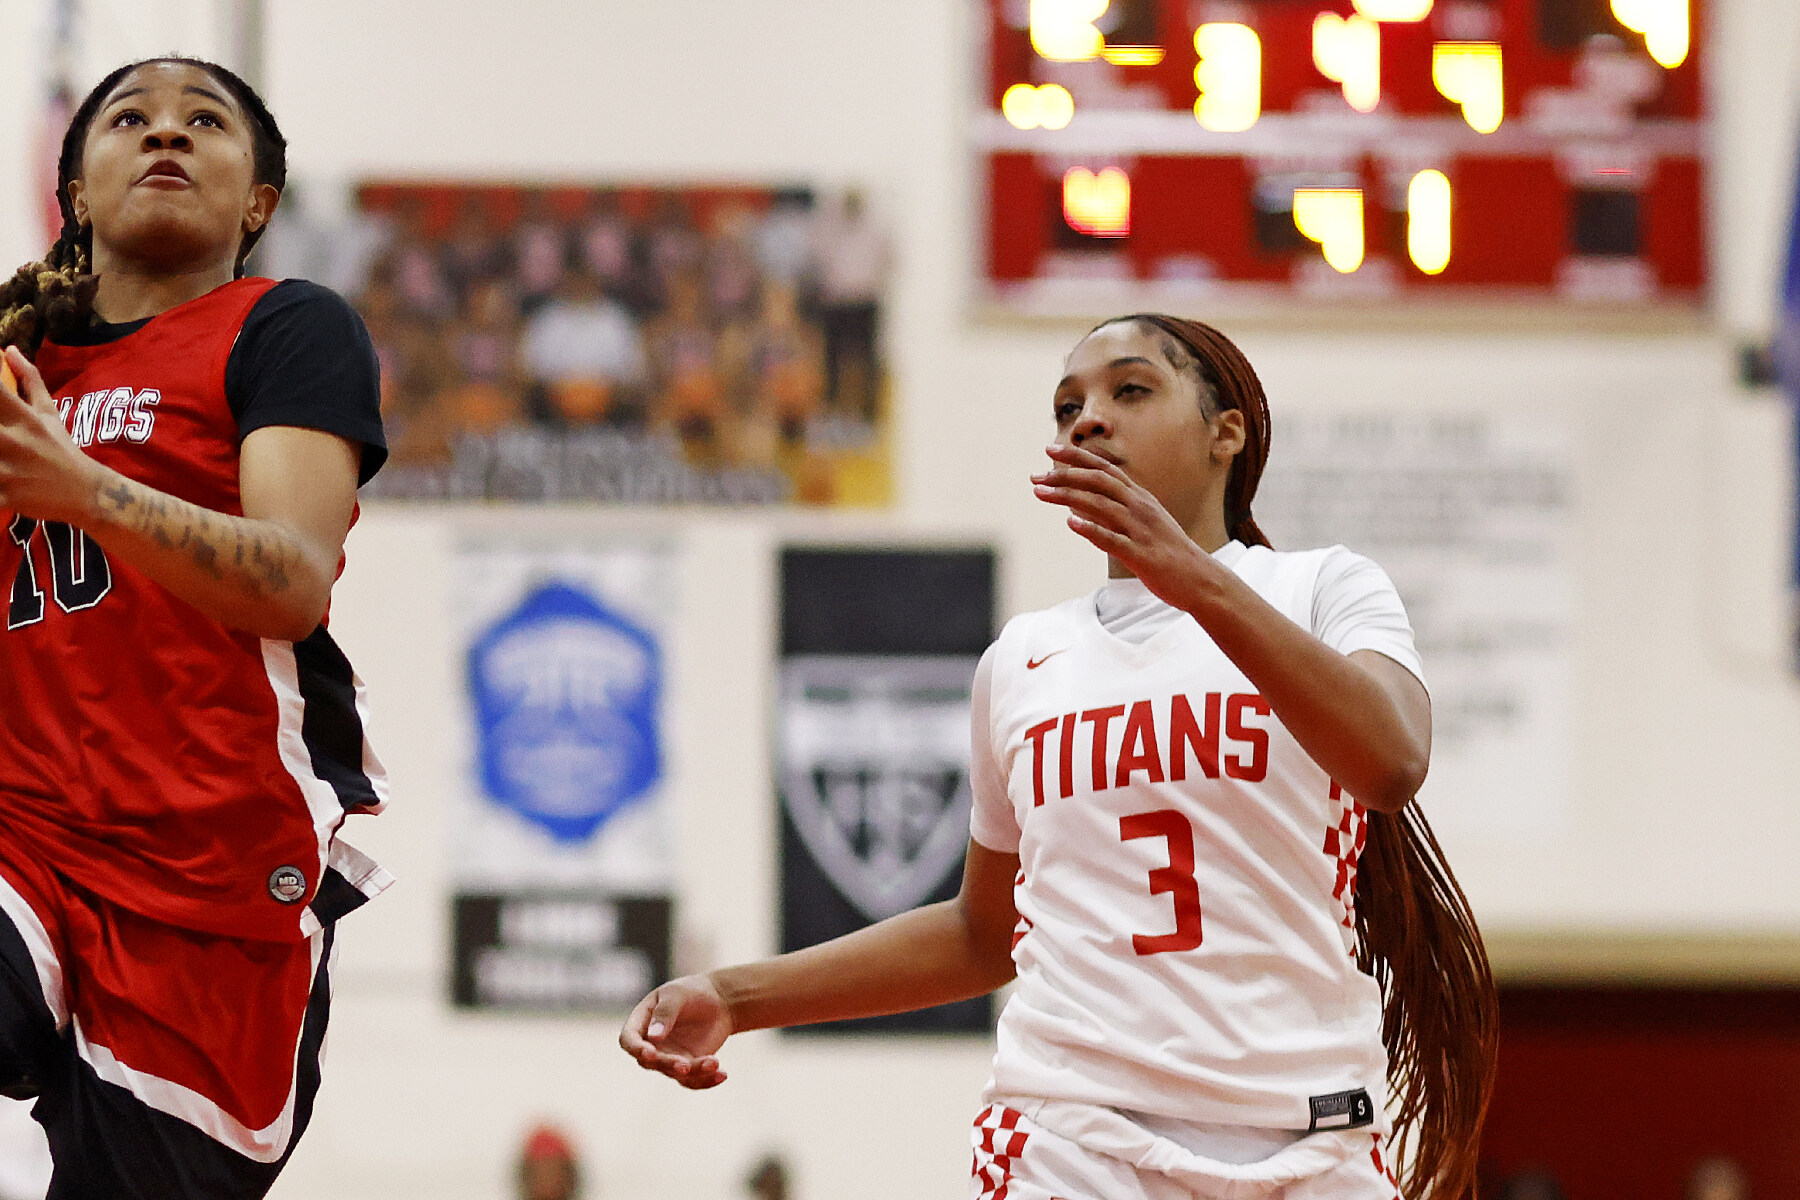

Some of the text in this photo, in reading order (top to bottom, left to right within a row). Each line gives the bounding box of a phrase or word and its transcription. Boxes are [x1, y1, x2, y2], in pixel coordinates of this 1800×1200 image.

[1024, 692, 1271, 808] TITANS
[1119, 809, 1203, 956] 3
[1357, 1098, 1366, 1117] S
